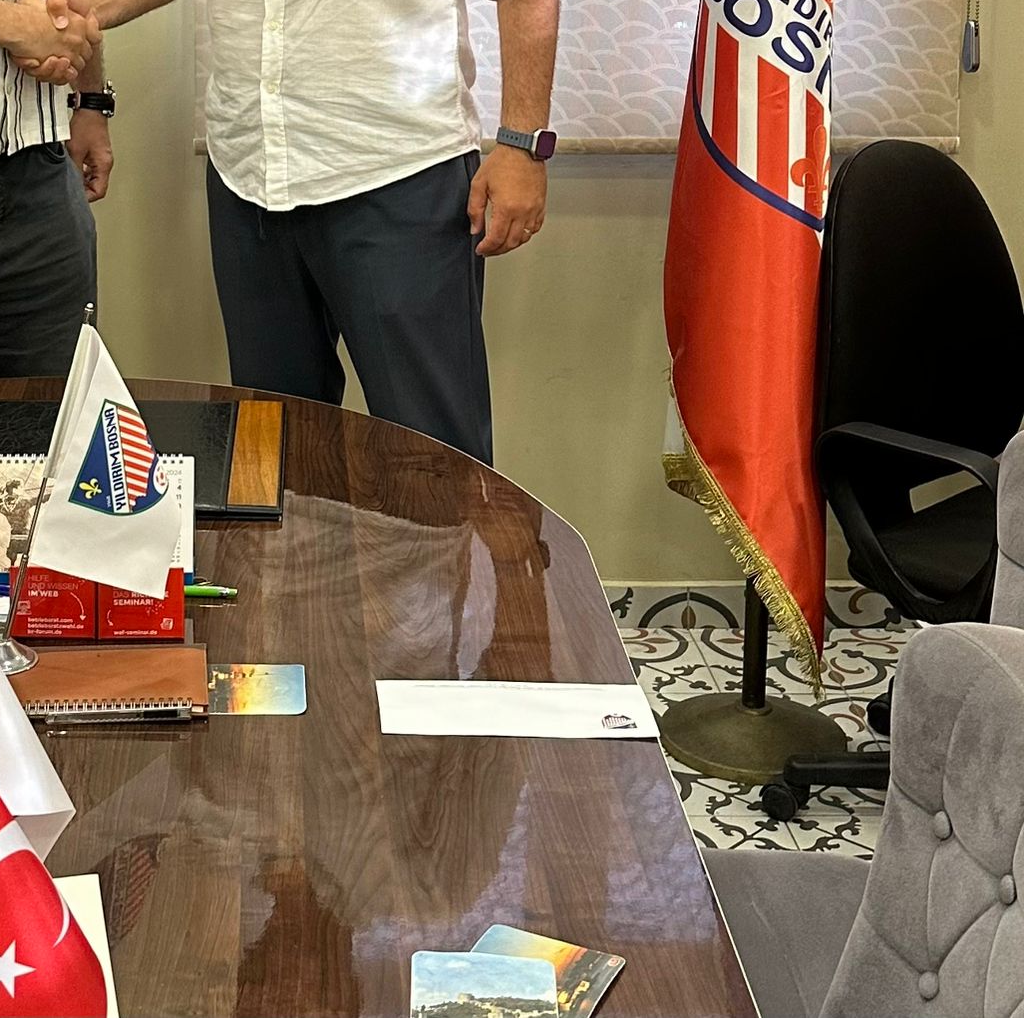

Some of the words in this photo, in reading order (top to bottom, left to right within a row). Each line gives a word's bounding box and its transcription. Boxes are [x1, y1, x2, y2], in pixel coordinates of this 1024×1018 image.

[104, 408, 120, 450] BOSNA
[110, 451, 126, 511] YILDIRIM
[39, 590, 59, 598] WEB
[47, 582, 79, 590] WISSEN
